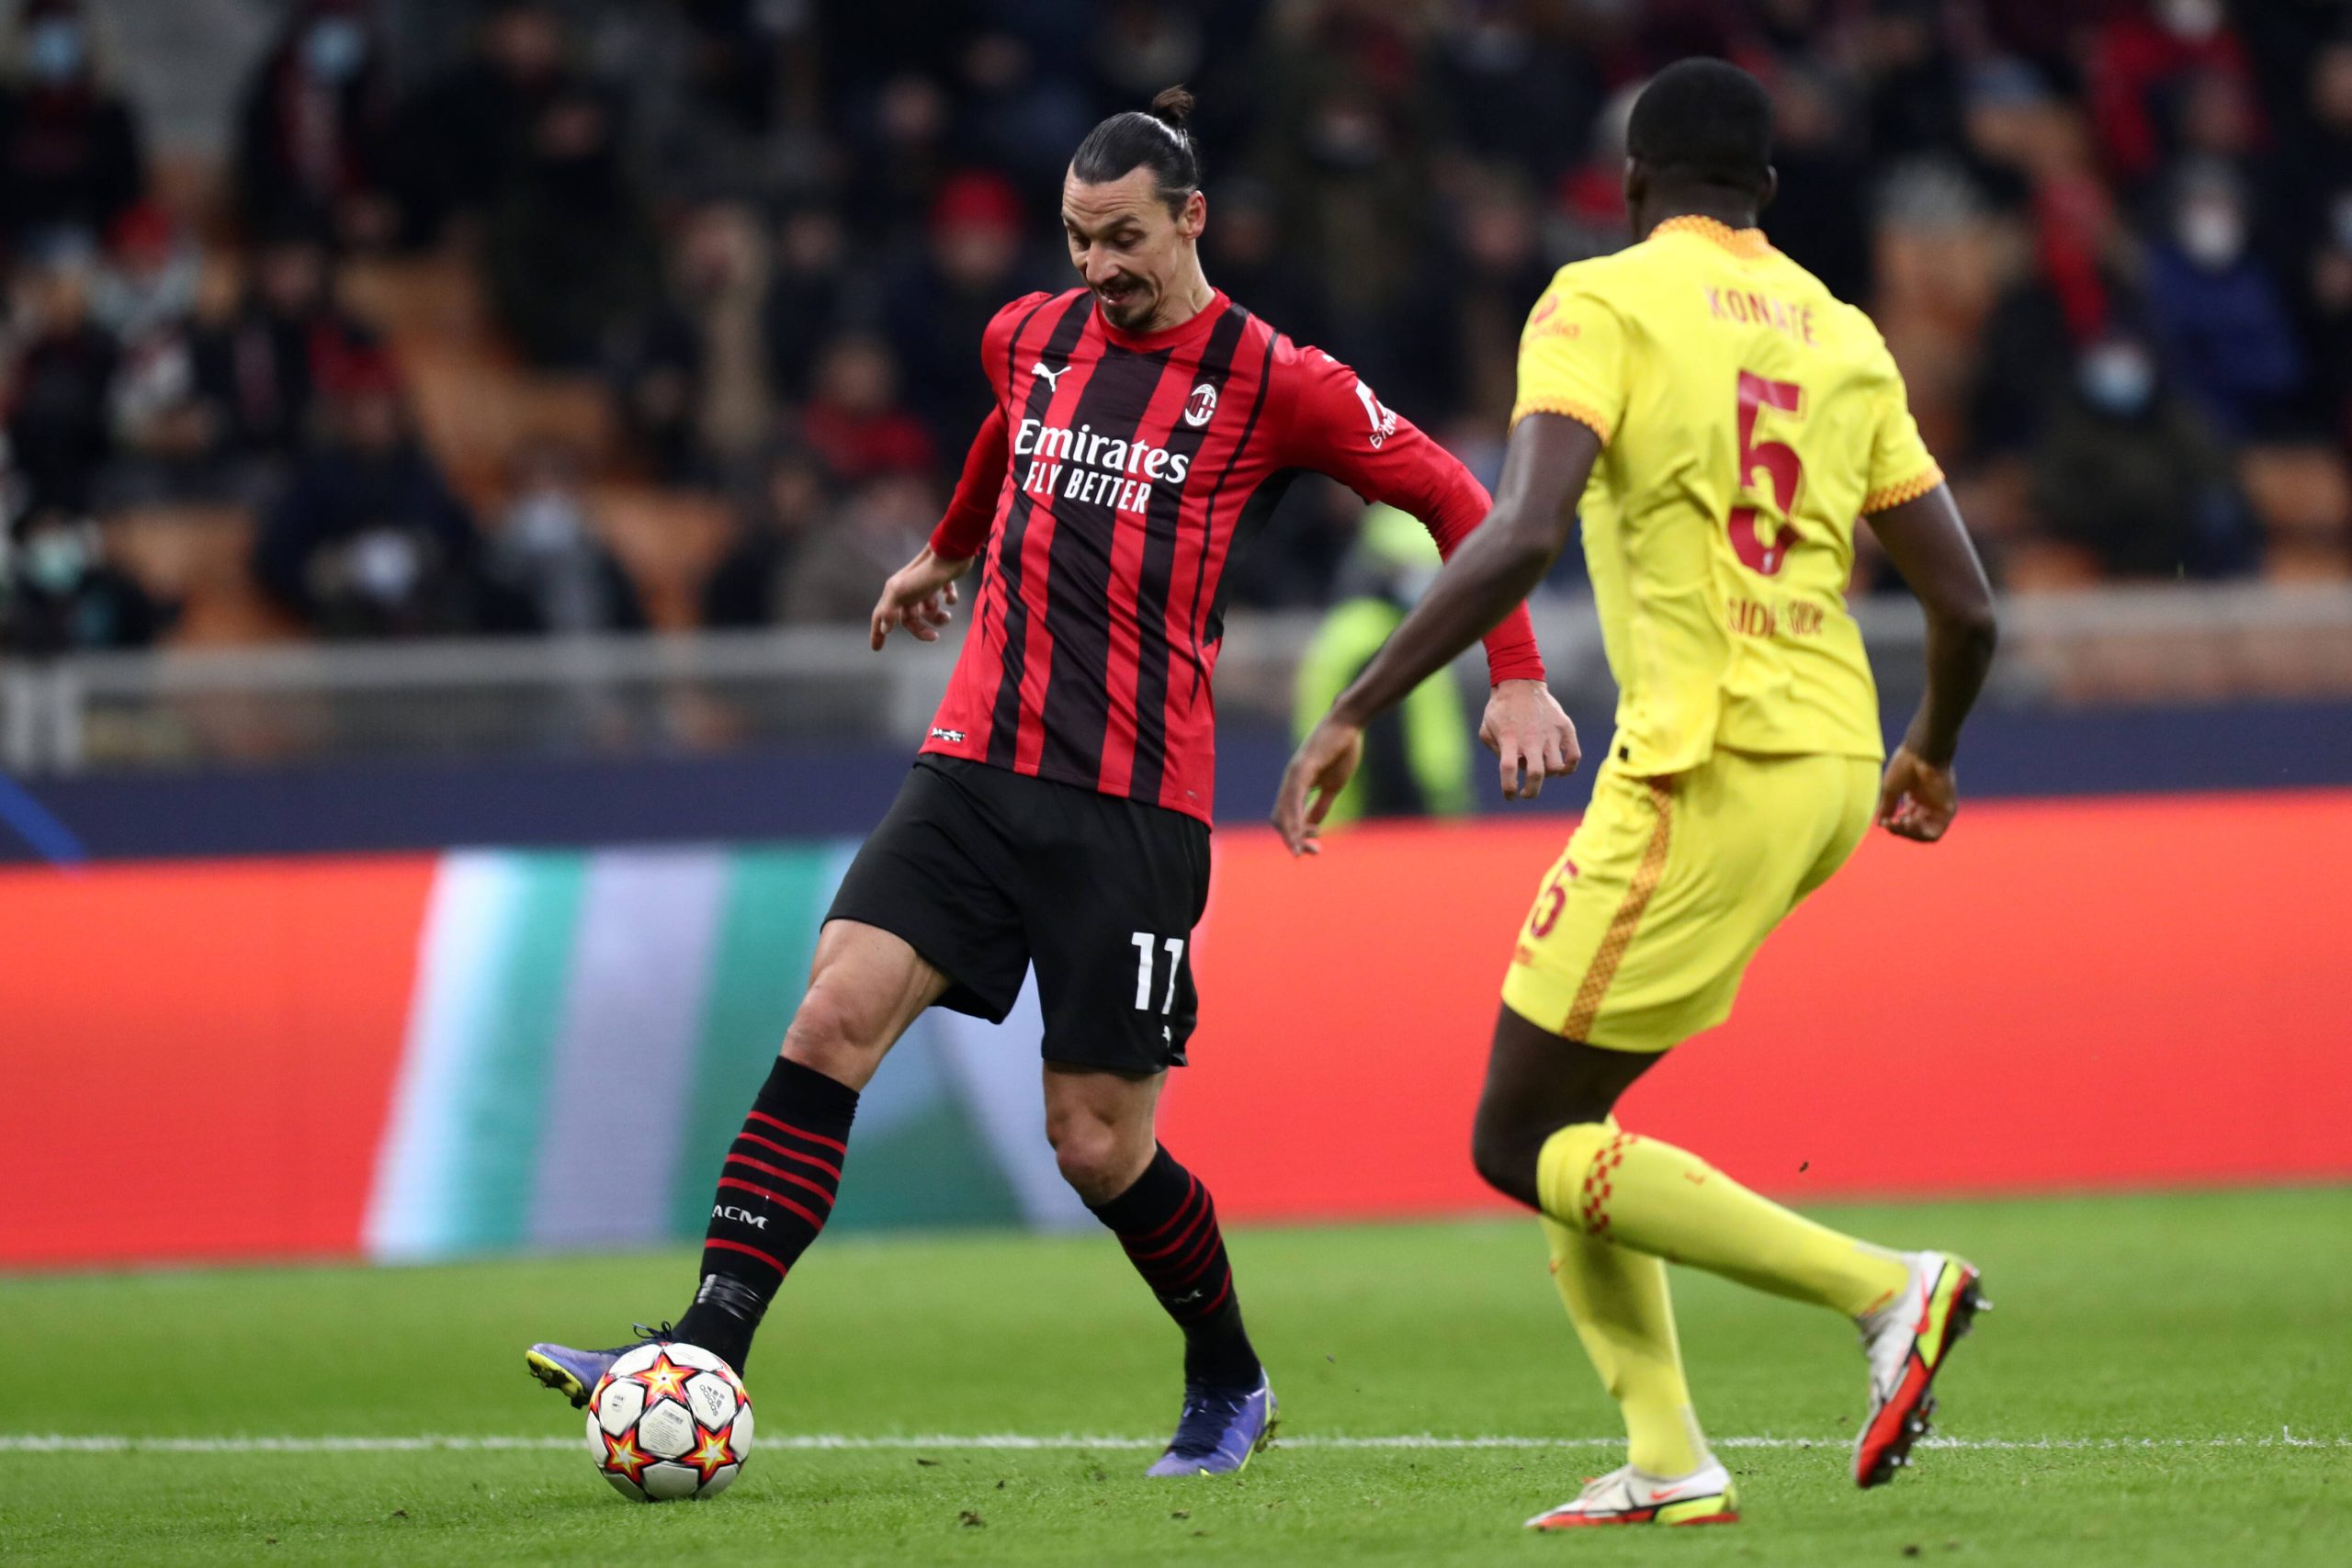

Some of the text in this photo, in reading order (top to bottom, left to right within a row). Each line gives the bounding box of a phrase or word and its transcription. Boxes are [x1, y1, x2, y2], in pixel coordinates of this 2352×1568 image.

[1015, 419, 1189, 483] Emirates
[1728, 368, 1802, 576] 5
[1023, 461, 1152, 514] FLY BETTER
[1532, 860, 1578, 939] 5
[1131, 931, 1184, 1015] 11
[712, 1204, 769, 1230] ACM
[699, 1384, 719, 1416] adidas
